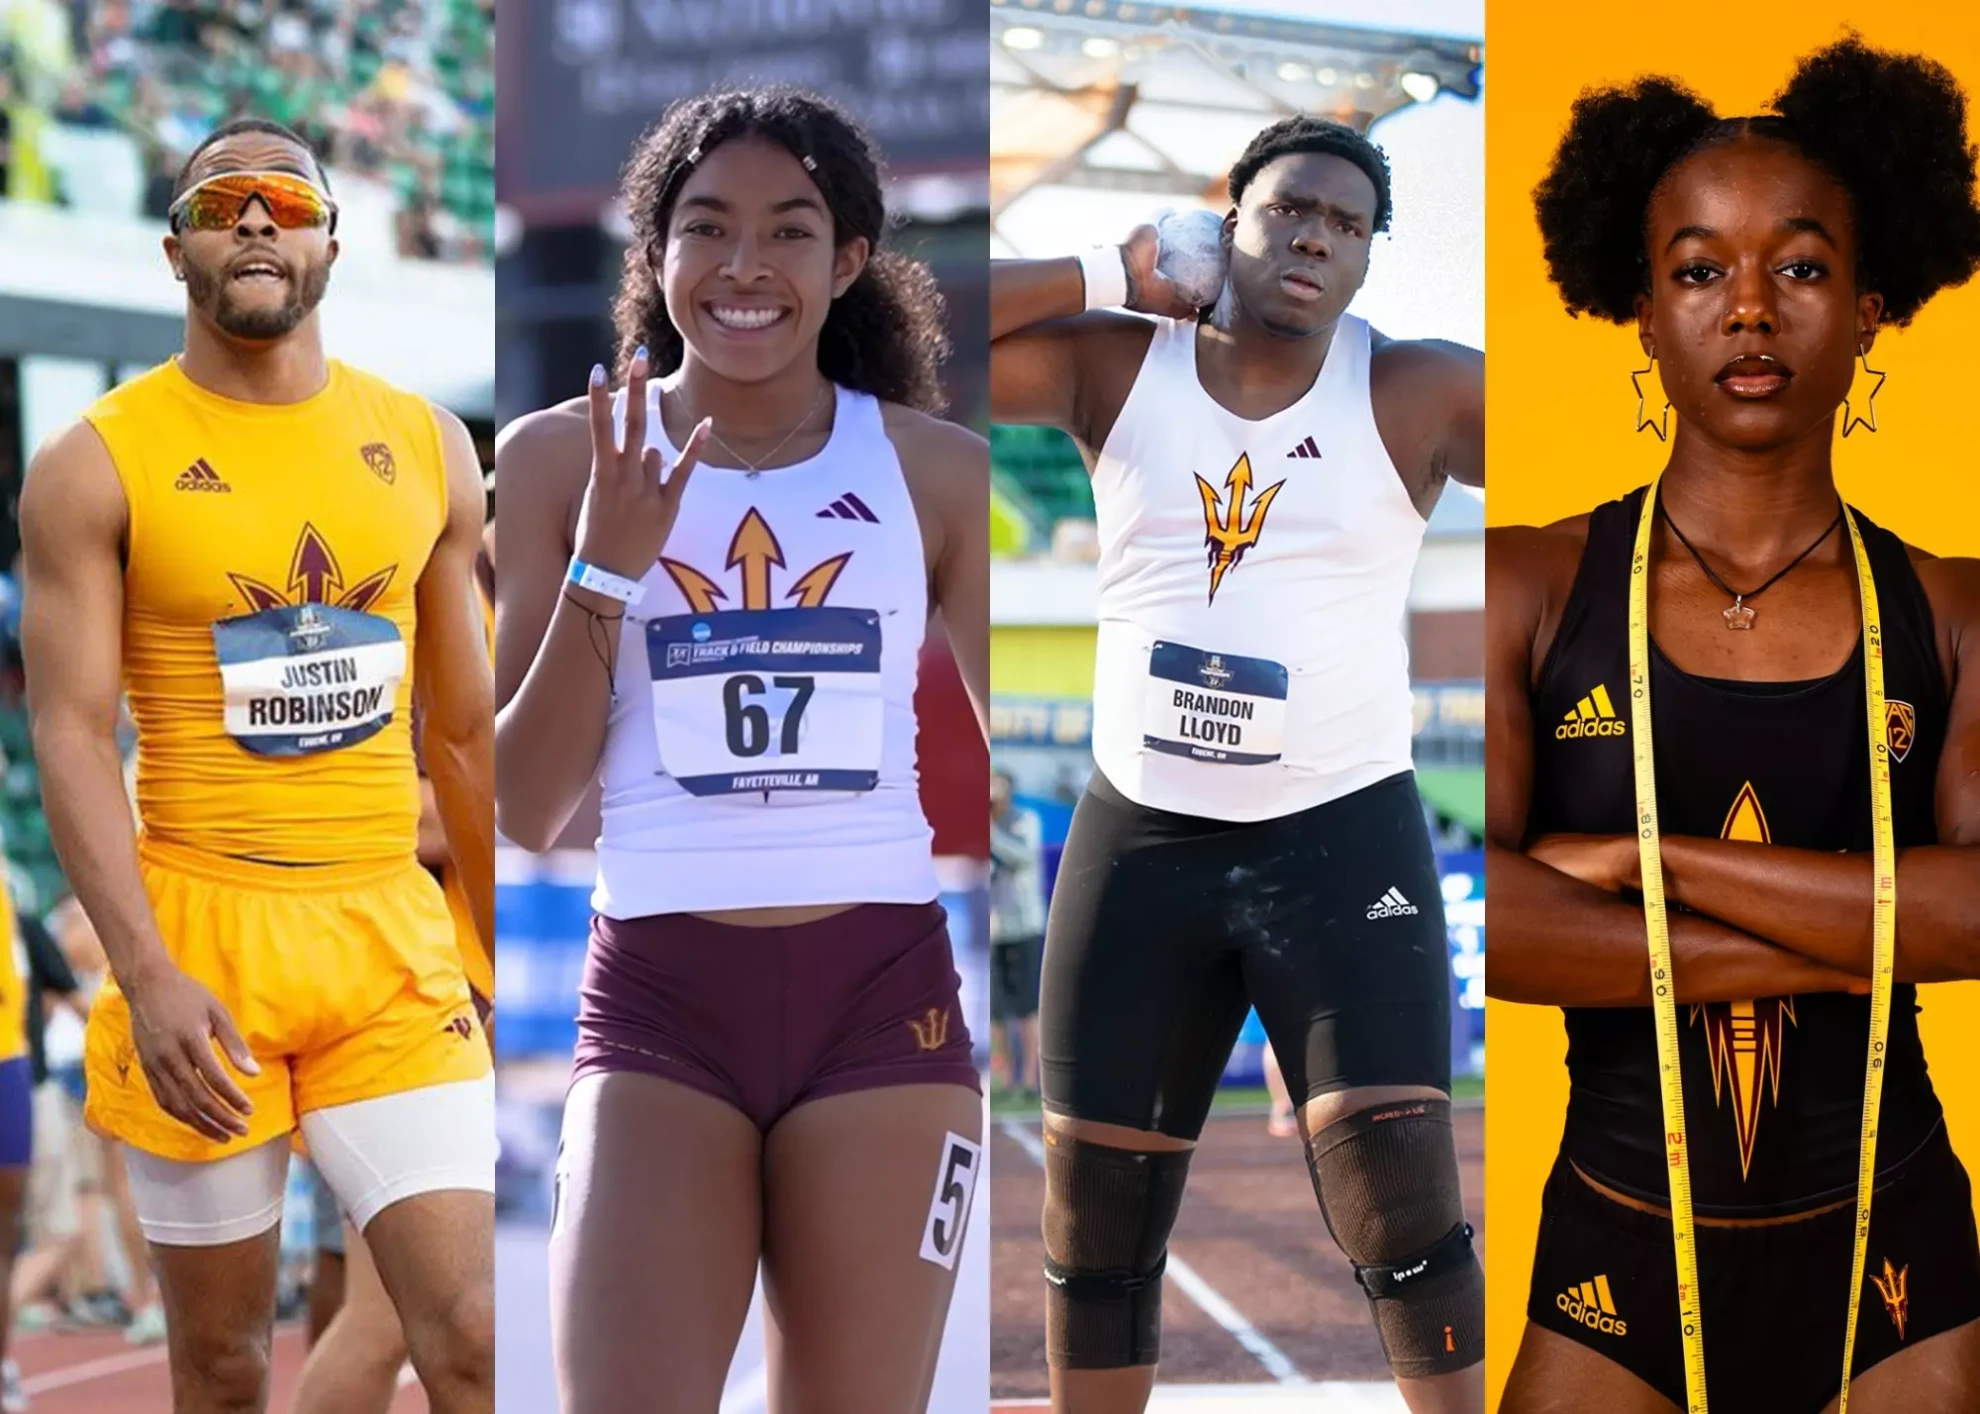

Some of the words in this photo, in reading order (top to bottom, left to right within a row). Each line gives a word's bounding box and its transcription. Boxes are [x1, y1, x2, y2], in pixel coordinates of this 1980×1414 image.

[174, 479, 232, 493] adidas
[693, 645, 729, 658] TRACK
[739, 640, 770, 655] FIELD
[771, 640, 864, 656] CHAMPIONSHIPS
[1869, 624, 1881, 647] 20
[281, 657, 358, 689] JUSTIN
[1633, 674, 1644, 699] 70
[250, 685, 384, 727] ROBINSON
[722, 674, 816, 758] 67
[1173, 689, 1254, 721] BRANDON
[1180, 715, 1242, 746] LLOYD
[1555, 717, 1627, 740] adidas
[1885, 702, 1913, 738] AC
[1887, 727, 1908, 749] 12
[1876, 743, 1889, 764] 10
[1641, 813, 1653, 840] 80
[1366, 904, 1419, 920] adidas
[1654, 968, 1668, 997] 90
[932, 1142, 974, 1257] 5
[1556, 1293, 1627, 1336] adidas
[1682, 1309, 1695, 1337] 10
